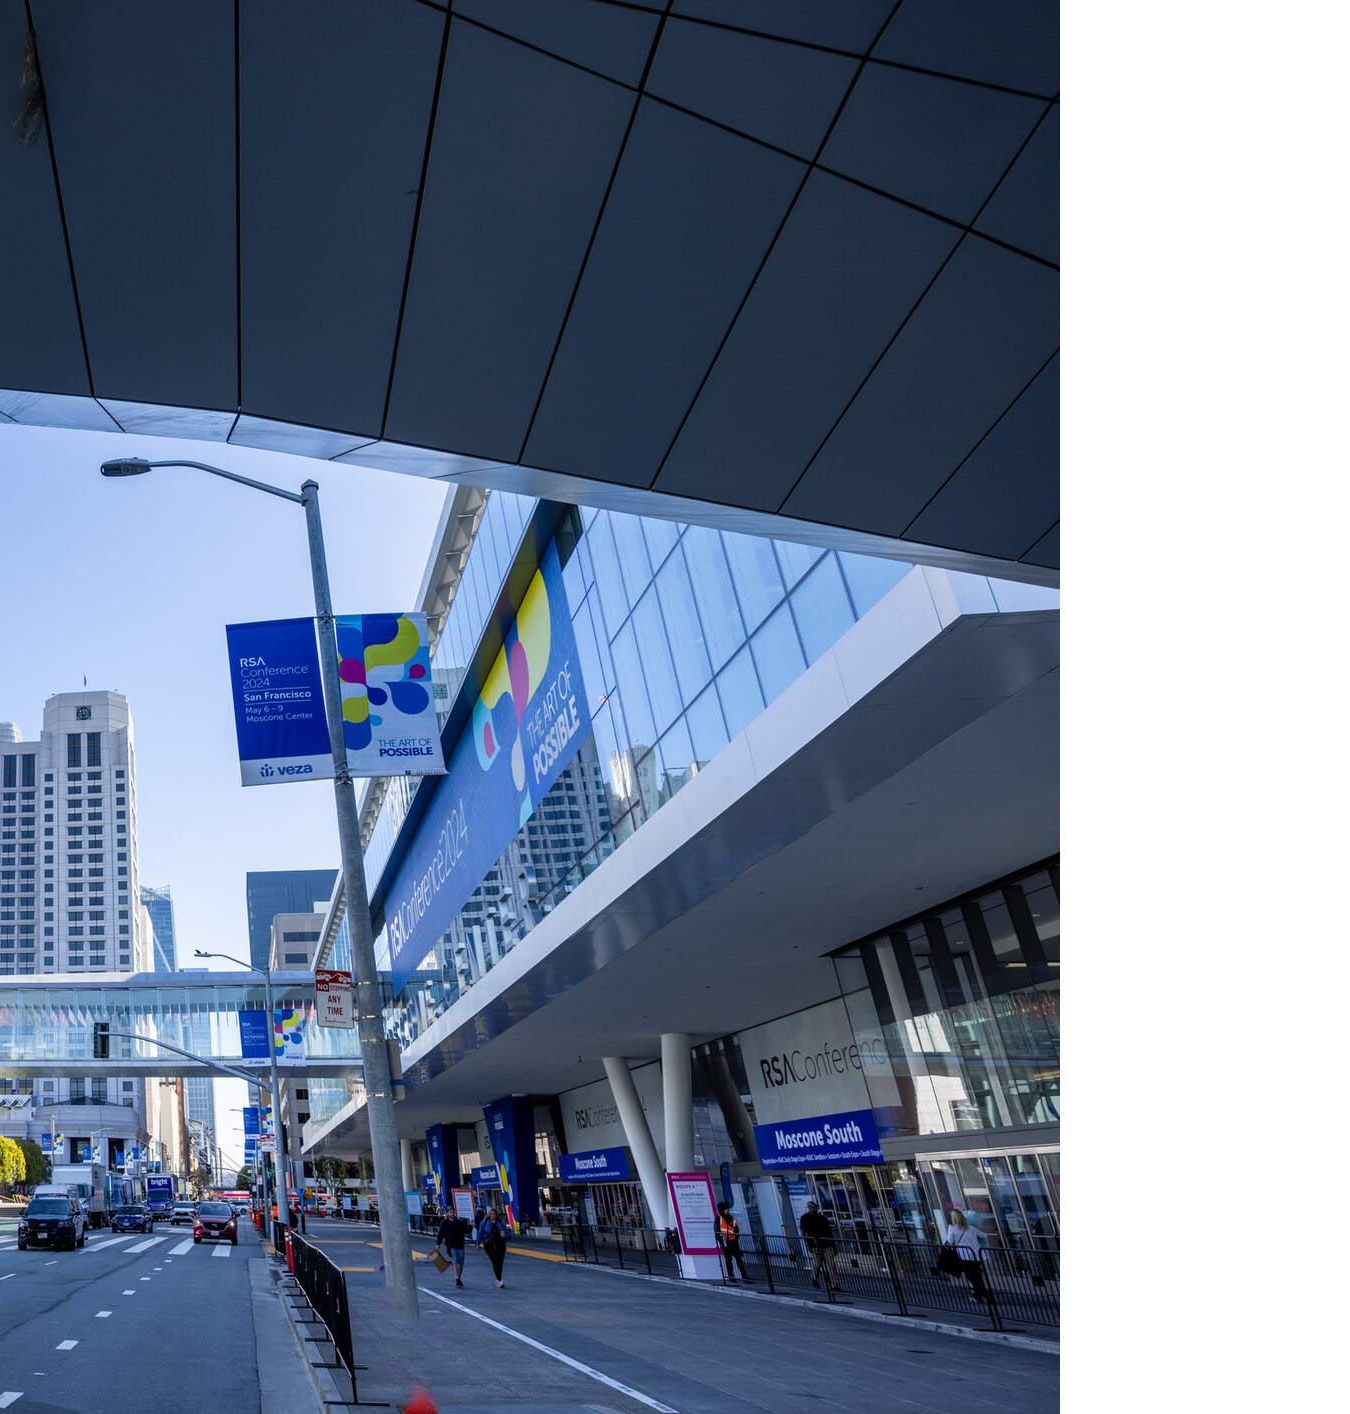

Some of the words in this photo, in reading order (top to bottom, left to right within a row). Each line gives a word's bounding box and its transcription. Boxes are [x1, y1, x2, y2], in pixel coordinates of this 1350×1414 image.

[240, 657, 265, 667] RSA
[243, 678, 270, 689] 2024
[244, 693, 262, 702] San
[265, 691, 311, 699] Francisco
[527, 708, 544, 749] THE
[543, 681, 558, 728] ART
[558, 660, 570, 700] OF
[245, 707, 262, 715] May
[247, 714, 283, 722] Moscone
[378, 739, 397, 748] THE
[399, 739, 419, 747] ART
[421, 738, 432, 746] OF
[533, 694, 580, 784] POSSIBLE
[379, 747, 433, 757] POSSIBLE
[277, 764, 313, 776] veza
[327, 995, 341, 1004] ANY
[327, 1007, 343, 1015] TIME
[775, 1130, 824, 1150] Moscone
[823, 1120, 863, 1145] South
[593, 1154, 607, 1167] South
